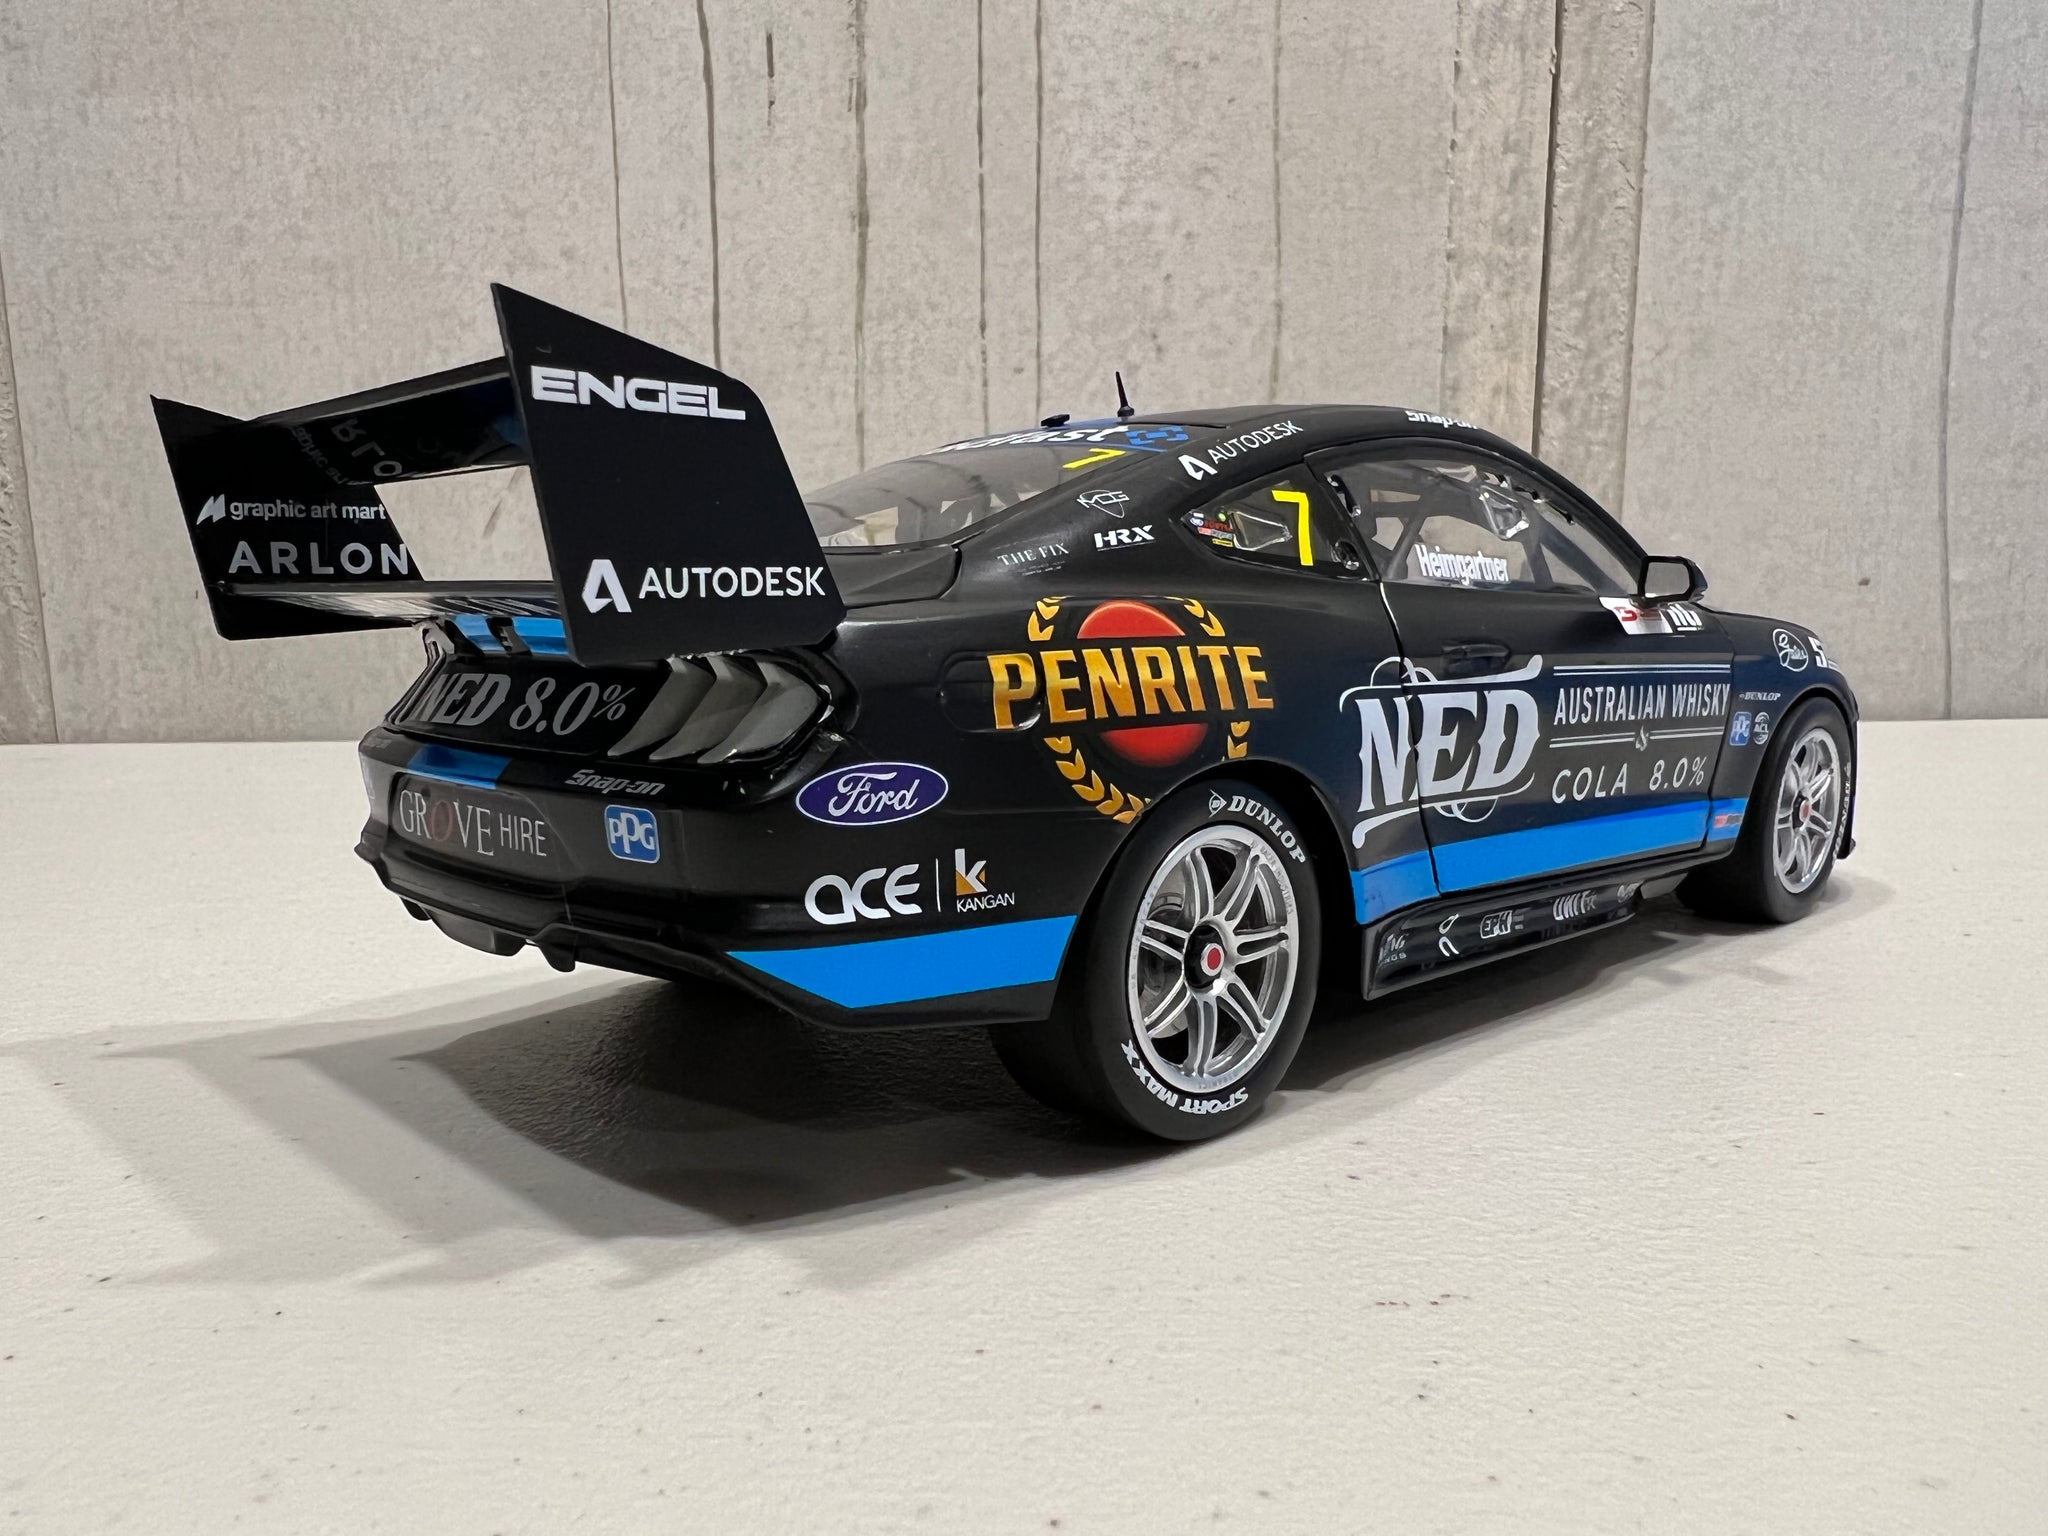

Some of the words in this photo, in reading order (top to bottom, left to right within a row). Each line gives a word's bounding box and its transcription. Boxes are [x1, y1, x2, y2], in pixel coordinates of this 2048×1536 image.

[531, 365, 746, 420] ENGEL
[1207, 420, 1304, 464] AUTODESK
[230, 500, 306, 521] graphic
[310, 503, 338, 519] art
[341, 504, 387, 520] mart
[1271, 490, 1314, 567] 7
[228, 541, 409, 575] ARLON
[997, 549, 1037, 566] THE
[1094, 524, 1156, 549] HRX
[639, 566, 826, 599] AUTODESK
[1414, 543, 1509, 586] Heimgartner
[509, 677, 636, 736] 8.0%
[986, 645, 1275, 730] PENRITE
[1553, 684, 1667, 726] AUSTRALIAN
[1672, 683, 1731, 718] WHISKY
[1744, 691, 1781, 701] DUNLOP
[1355, 689, 1541, 813] NED
[564, 768, 666, 796] Snap-on
[827, 771, 921, 817] Ford
[1551, 762, 1628, 804] COLA
[1649, 756, 1708, 791] 8.0%
[399, 789, 495, 858] GROVE
[498, 811, 548, 857] HIRE
[607, 811, 657, 855] PPG
[1226, 794, 1307, 864] DUNLOP
[956, 892, 1016, 914] KANGAN
[1120, 1039, 1178, 1109] MAXX
[1179, 1086, 1249, 1115] SPORT
